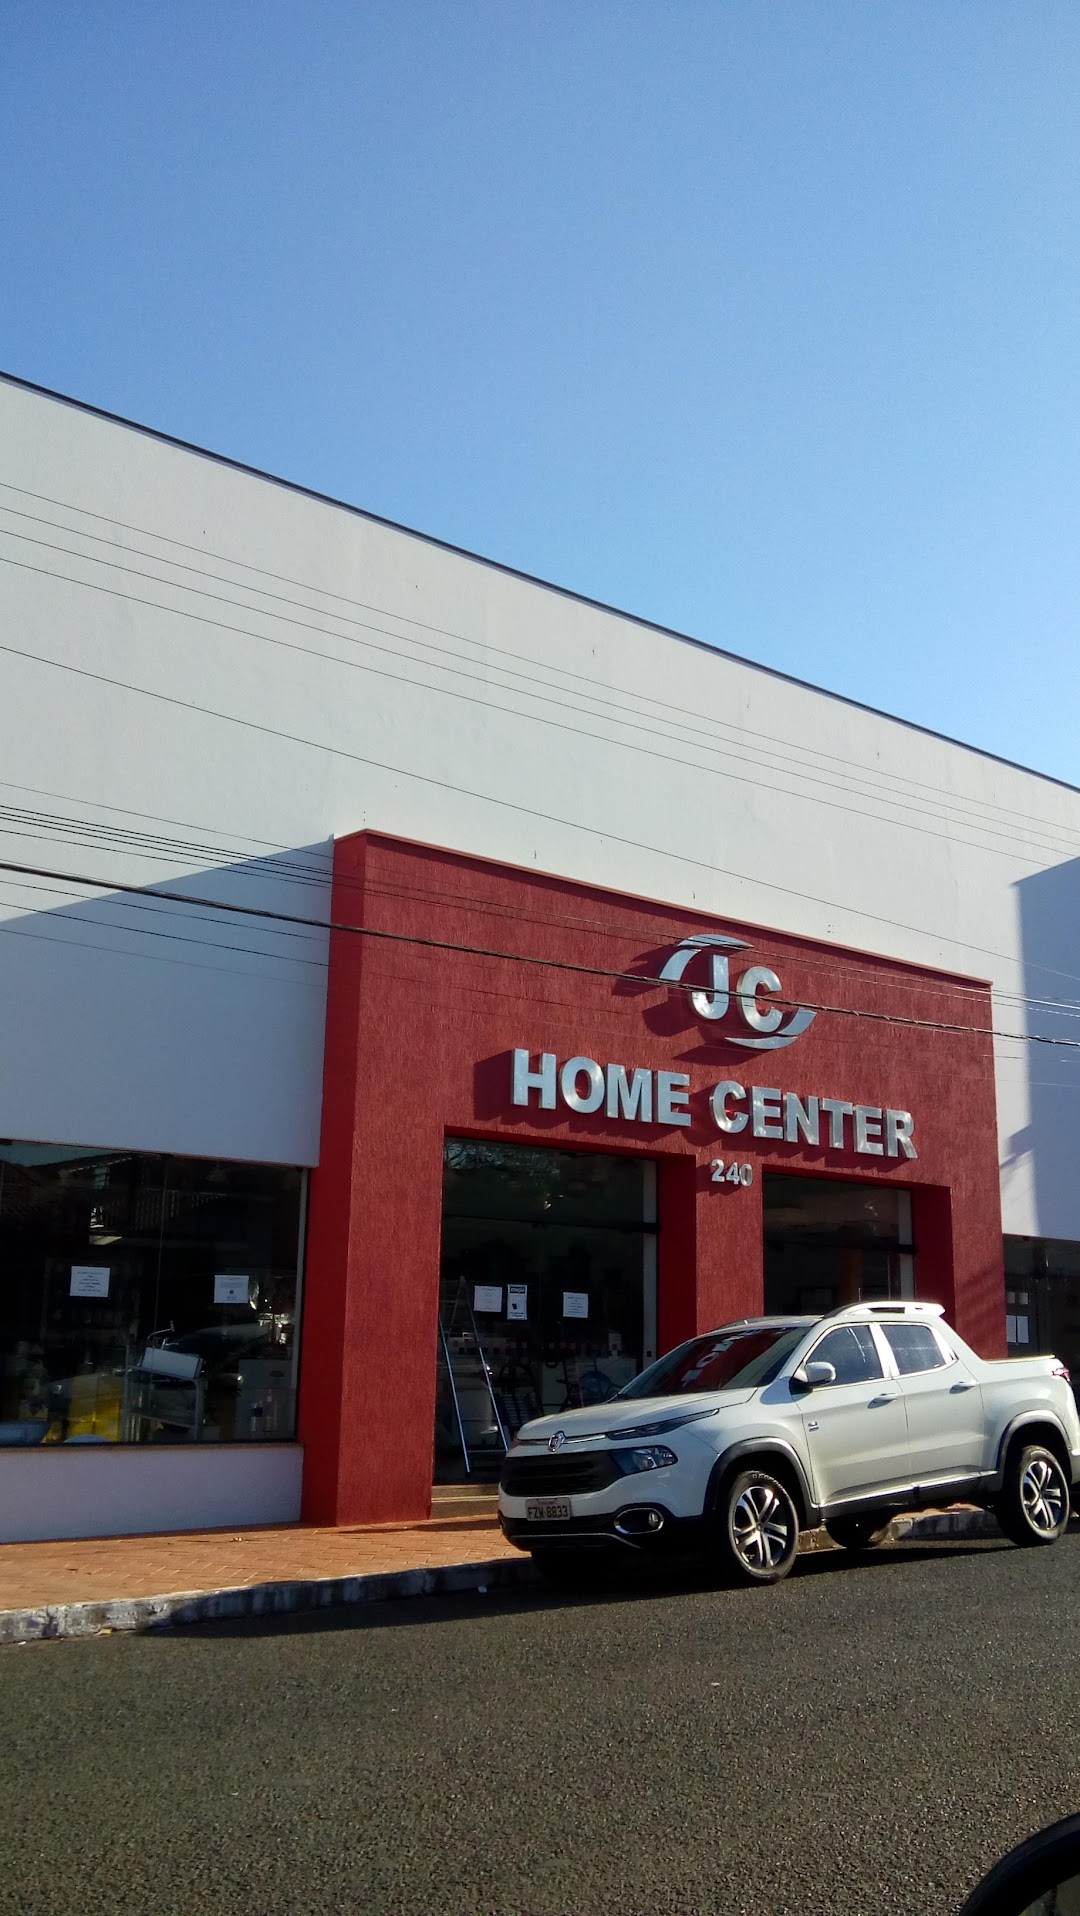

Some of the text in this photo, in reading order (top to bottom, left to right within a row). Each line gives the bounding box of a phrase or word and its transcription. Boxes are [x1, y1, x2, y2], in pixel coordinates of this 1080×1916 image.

[690, 953, 784, 1034] JC
[510, 1047, 918, 1160] HOME CENTER
[710, 1158, 754, 1188] 240
